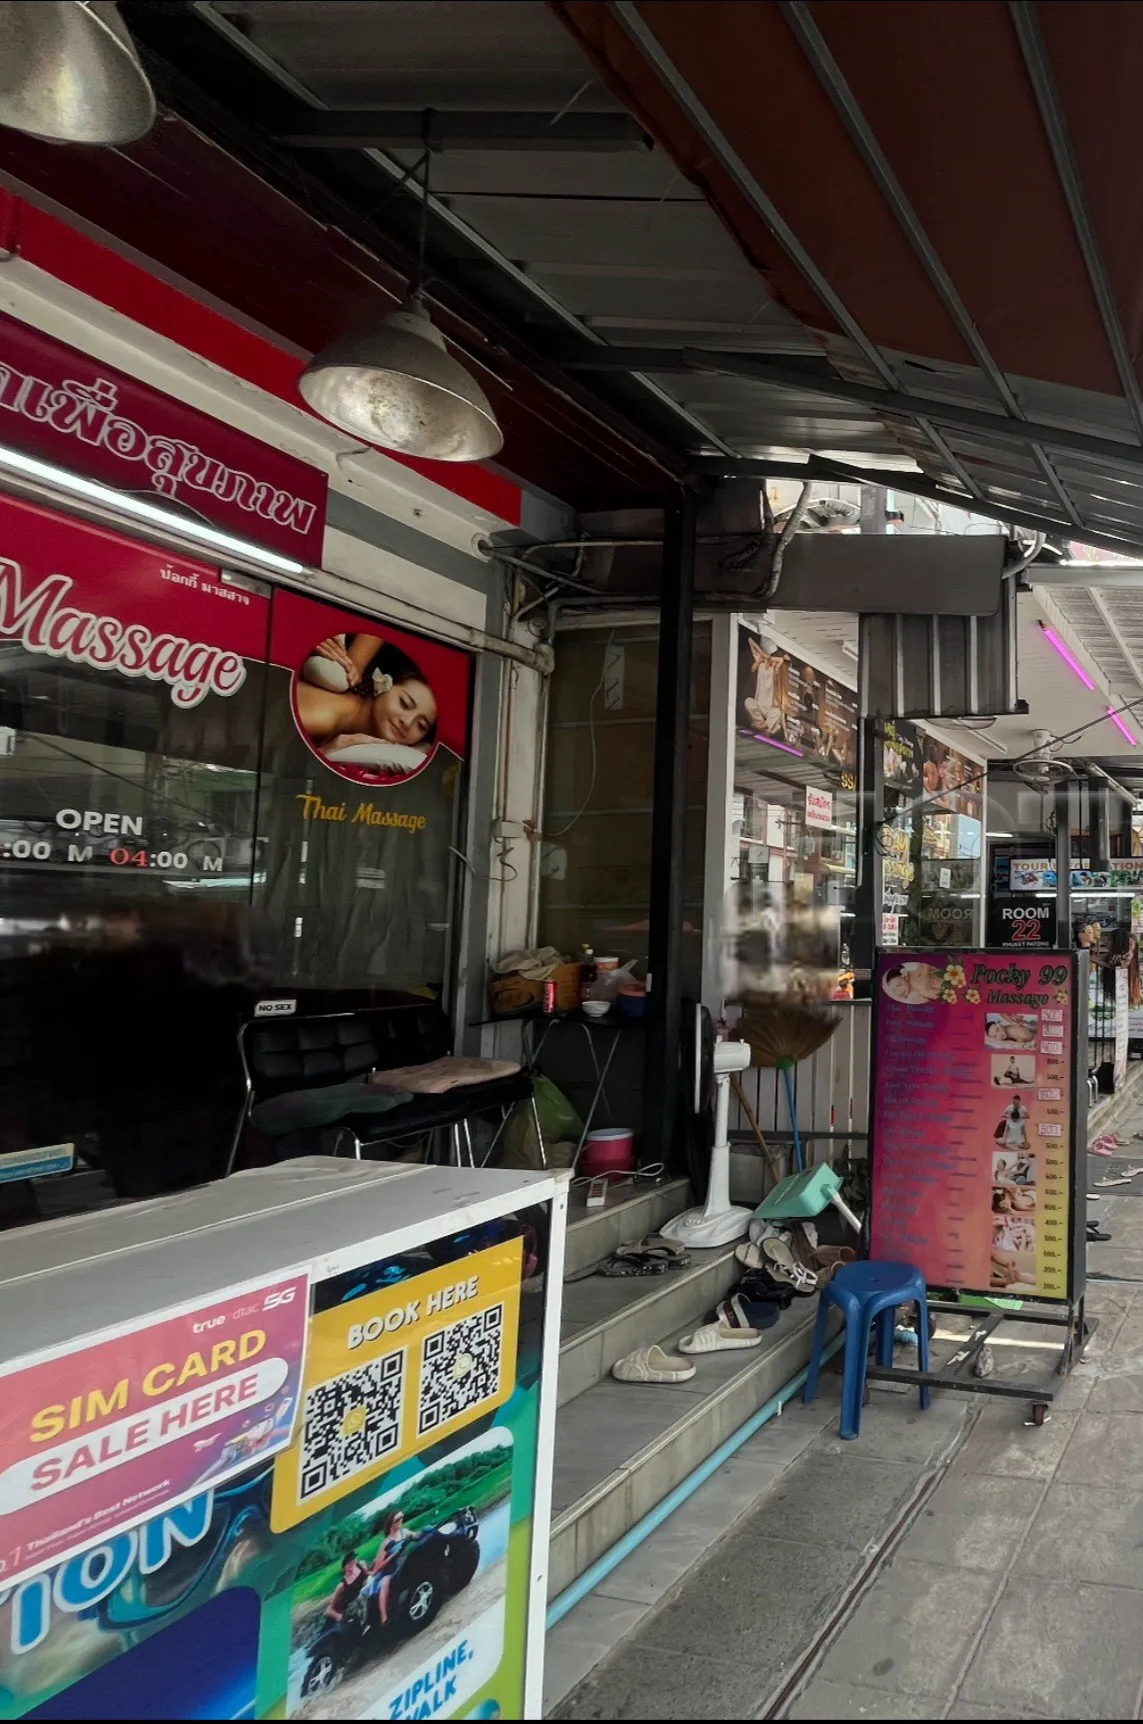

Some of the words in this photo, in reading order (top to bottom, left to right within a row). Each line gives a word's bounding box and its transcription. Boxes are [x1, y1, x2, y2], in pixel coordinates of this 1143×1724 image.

[0, 558, 246, 708] Massage
[56, 808, 143, 835] OPEN
[296, 794, 347, 820] Thai
[351, 803, 426, 834] Massage
[0, 840, 51, 860] :00
[110, 848, 188, 869] 04:00
[1002, 907, 1050, 920] ROOM
[1012, 919, 1041, 941] 22
[971, 963, 1031, 991] Pocky
[1038, 965, 1068, 986] 99
[274, 1003, 293, 1011] SEX
[986, 989, 1049, 1009] Massage
[193, 1315, 226, 1334] true
[232, 1304, 260, 1320] dtac
[348, 1301, 420, 1350] BOOK
[427, 1275, 480, 1317] HERE
[30, 1378, 130, 1443] SIM
[142, 1329, 267, 1397] CARD
[31, 1418, 150, 1492] SALE
[159, 1373, 259, 1436] HERE
[93, 1501, 121, 1521] Best
[122, 1479, 170, 1505] Network
[0, 1489, 215, 1656] ION
